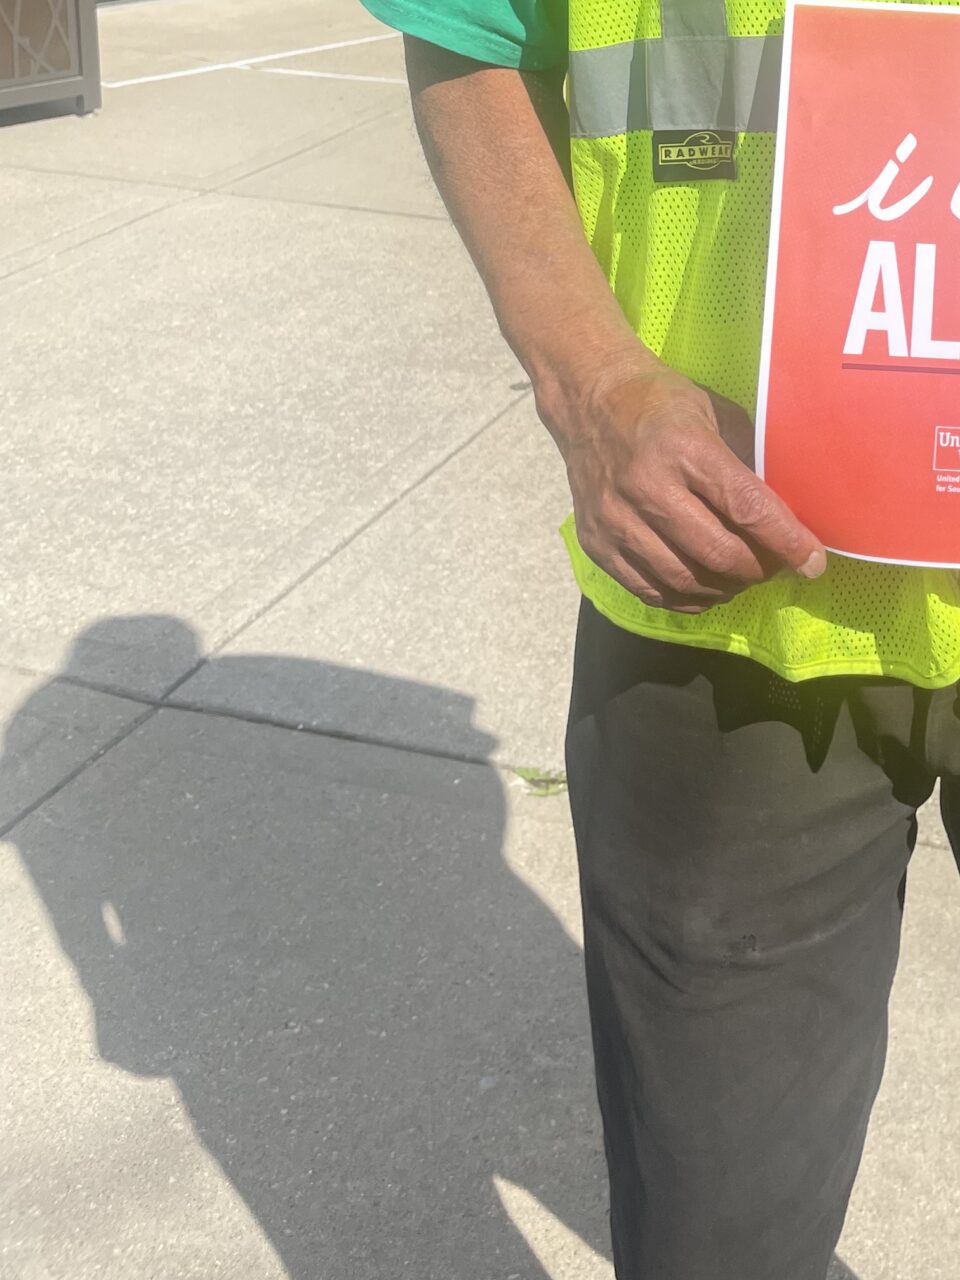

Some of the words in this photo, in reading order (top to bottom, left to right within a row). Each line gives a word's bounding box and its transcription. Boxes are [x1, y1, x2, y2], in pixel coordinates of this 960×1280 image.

[832, 133, 934, 221] i
[937, 475, 960, 483] United
[935, 484, 946, 492] for
